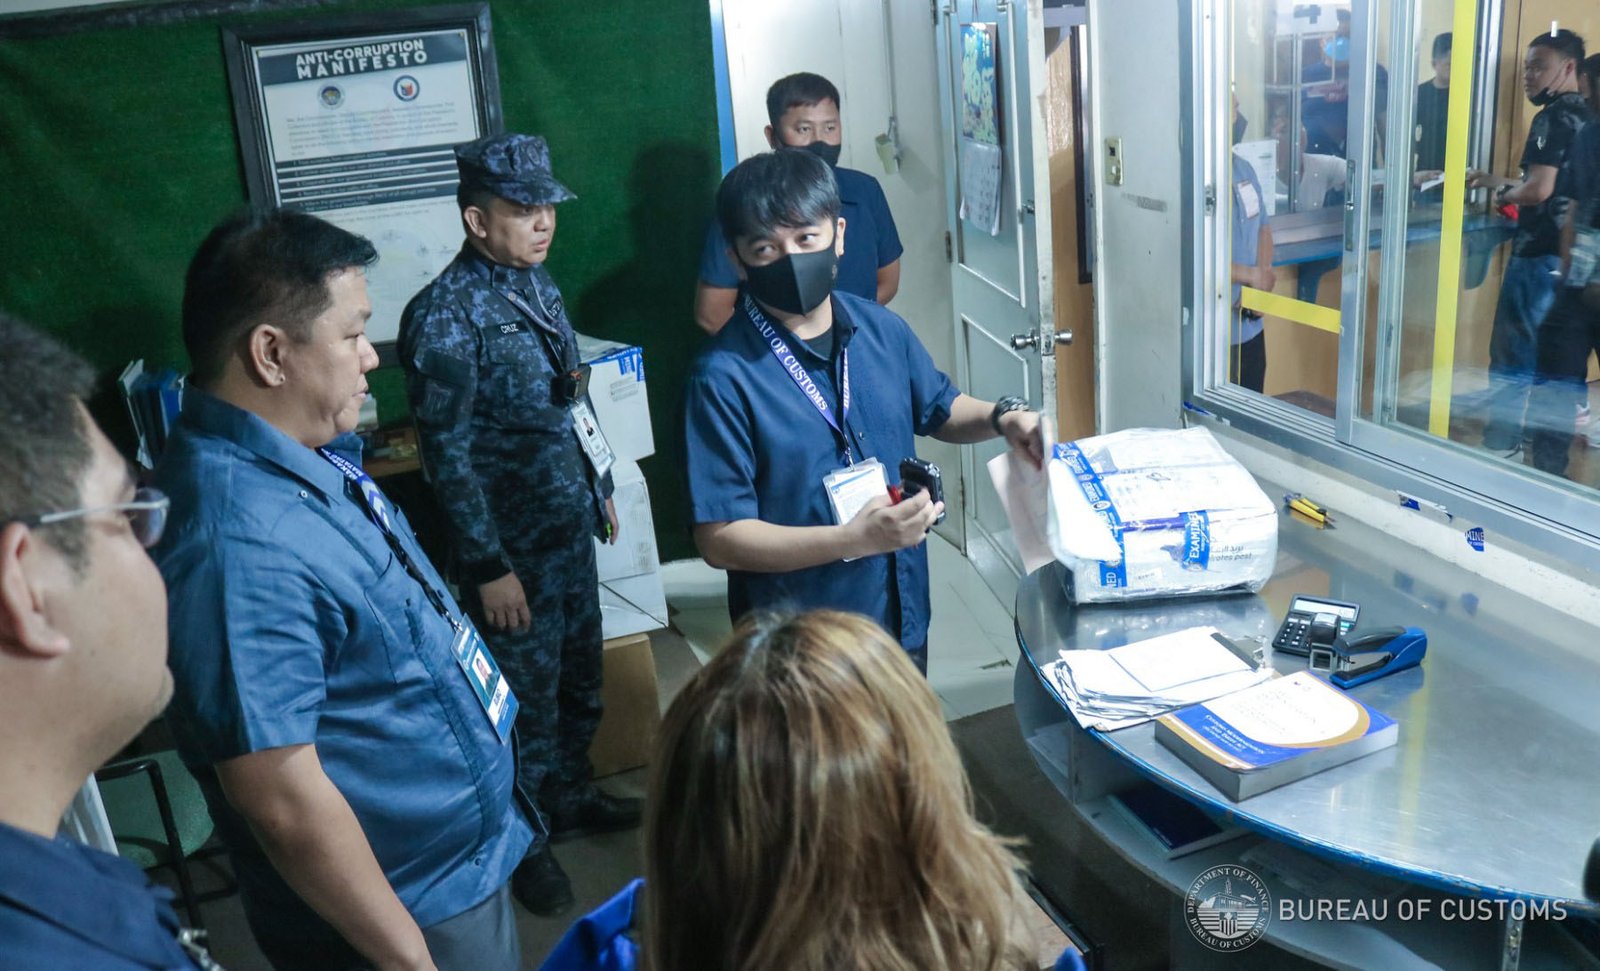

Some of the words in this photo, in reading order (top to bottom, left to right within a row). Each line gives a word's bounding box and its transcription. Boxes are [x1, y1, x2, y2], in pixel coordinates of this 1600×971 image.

[296, 39, 424, 66] ANTI-CORRUPTION
[296, 50, 427, 79] MANIFESTO
[500, 323, 519, 334] CRUZ
[770, 337, 789, 354] OF
[783, 355, 828, 410] CUSTOMS
[1188, 512, 1201, 558] EXAMINE
